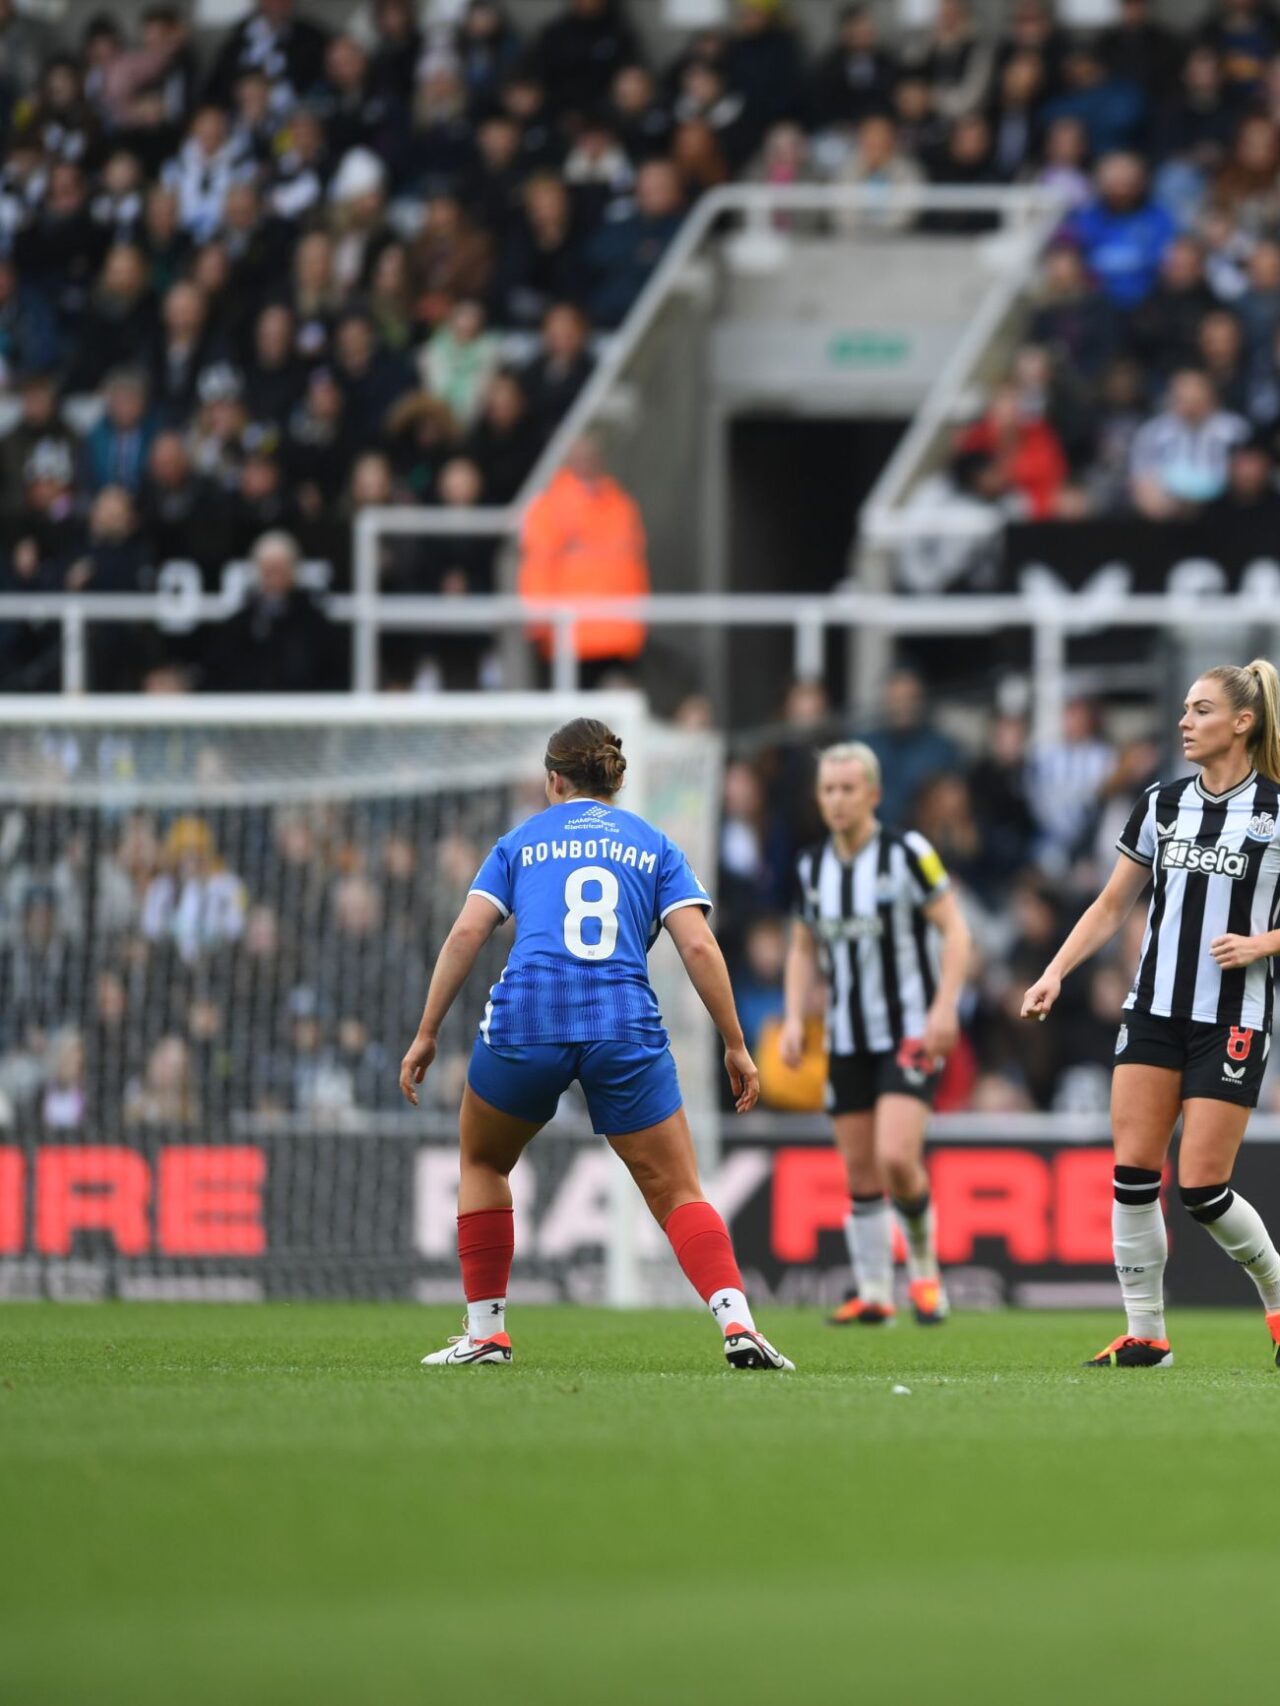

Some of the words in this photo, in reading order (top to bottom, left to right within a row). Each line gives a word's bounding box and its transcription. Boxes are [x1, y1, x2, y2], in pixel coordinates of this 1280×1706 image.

[521, 838, 657, 874] ROWBOTHAM
[1185, 846, 1247, 878] sela
[563, 865, 619, 961] 8
[1226, 1025, 1254, 1061] 8
